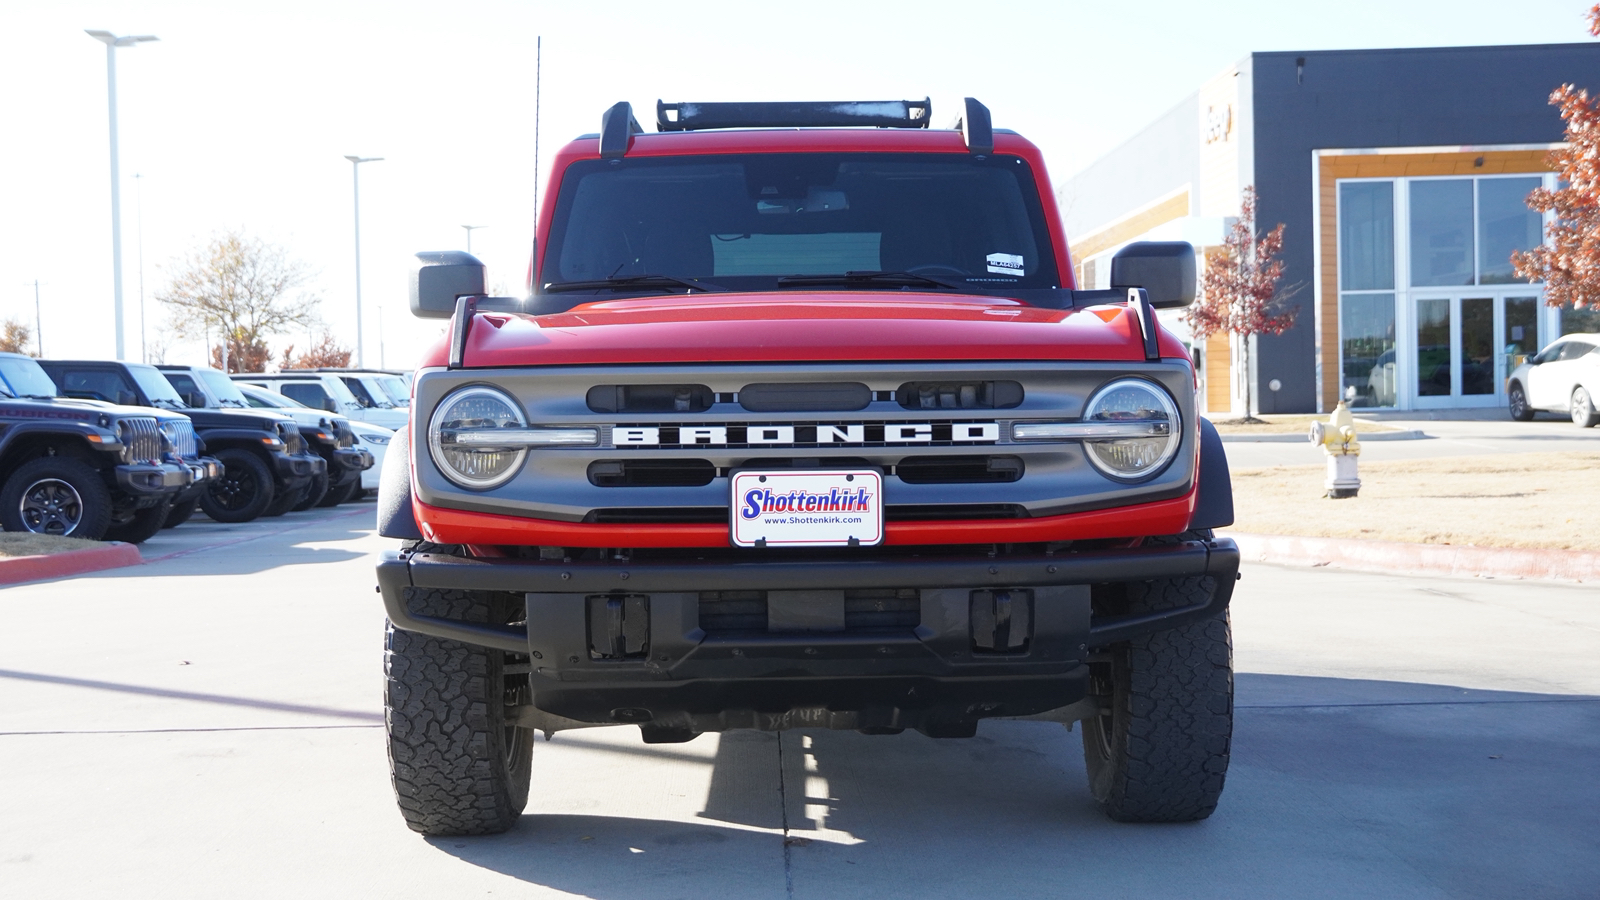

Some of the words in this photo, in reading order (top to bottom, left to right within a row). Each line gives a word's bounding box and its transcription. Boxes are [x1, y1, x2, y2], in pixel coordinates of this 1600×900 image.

[612, 424, 999, 445] BRONCO
[742, 488, 871, 520] Shottenkirk
[764, 516, 862, 524] www.Shottenkirk.com
